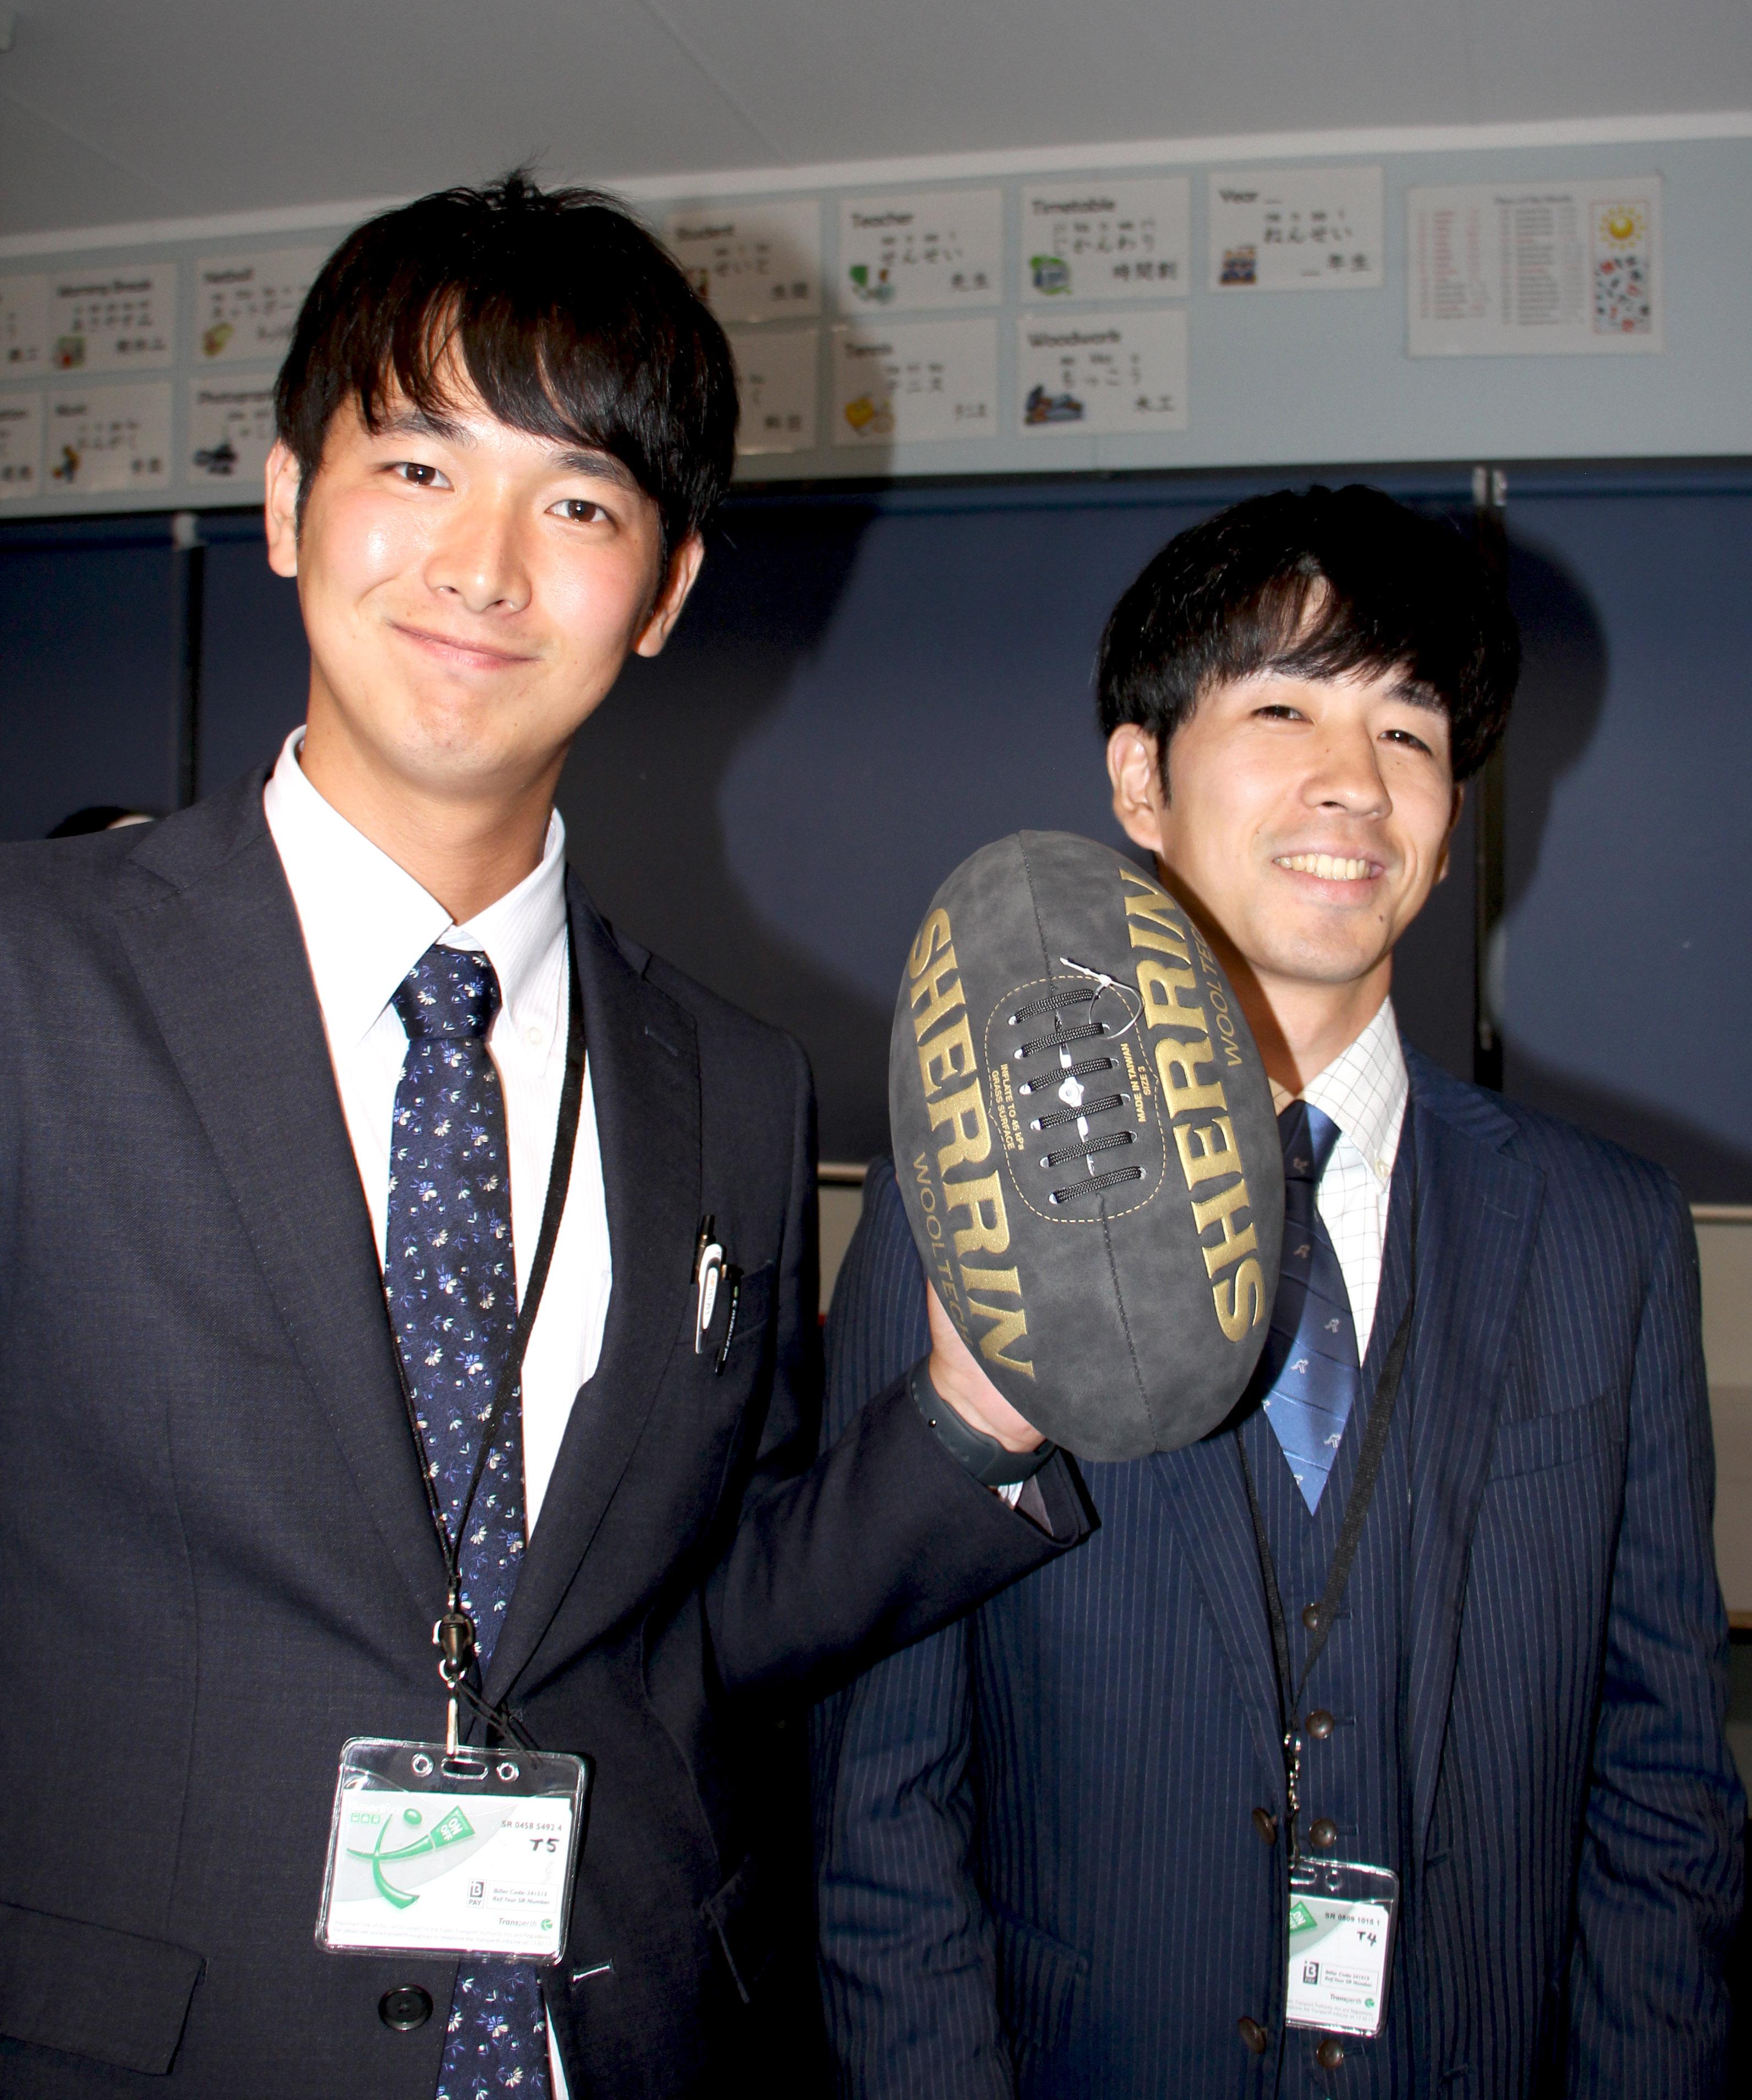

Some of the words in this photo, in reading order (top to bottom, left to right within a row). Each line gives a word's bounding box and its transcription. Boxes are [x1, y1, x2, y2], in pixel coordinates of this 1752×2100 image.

[1206, 981, 1242, 1066] WOOL
[1120, 1043, 1137, 1080] TAIWAN
[1000, 1063, 1014, 1102] INFLATE
[1130, 1080, 1140, 1091] IN
[1140, 1074, 1151, 1096] SIZE
[992, 1070, 1003, 1103] GRASS
[998, 1104, 1015, 1150] SURFACE
[1008, 1103, 1016, 1117] TO
[1120, 868, 1266, 1342] SHERRIN
[1134, 1092, 1147, 1123] MADE
[1011, 1119, 1020, 1131] 45
[908, 908, 1035, 1382] SHERRIN
[913, 1152, 945, 1258] WOOL
[440, 1825, 453, 1841] OFF
[448, 1817, 463, 1835] ON
[498, 1917, 537, 1927] Transperth
